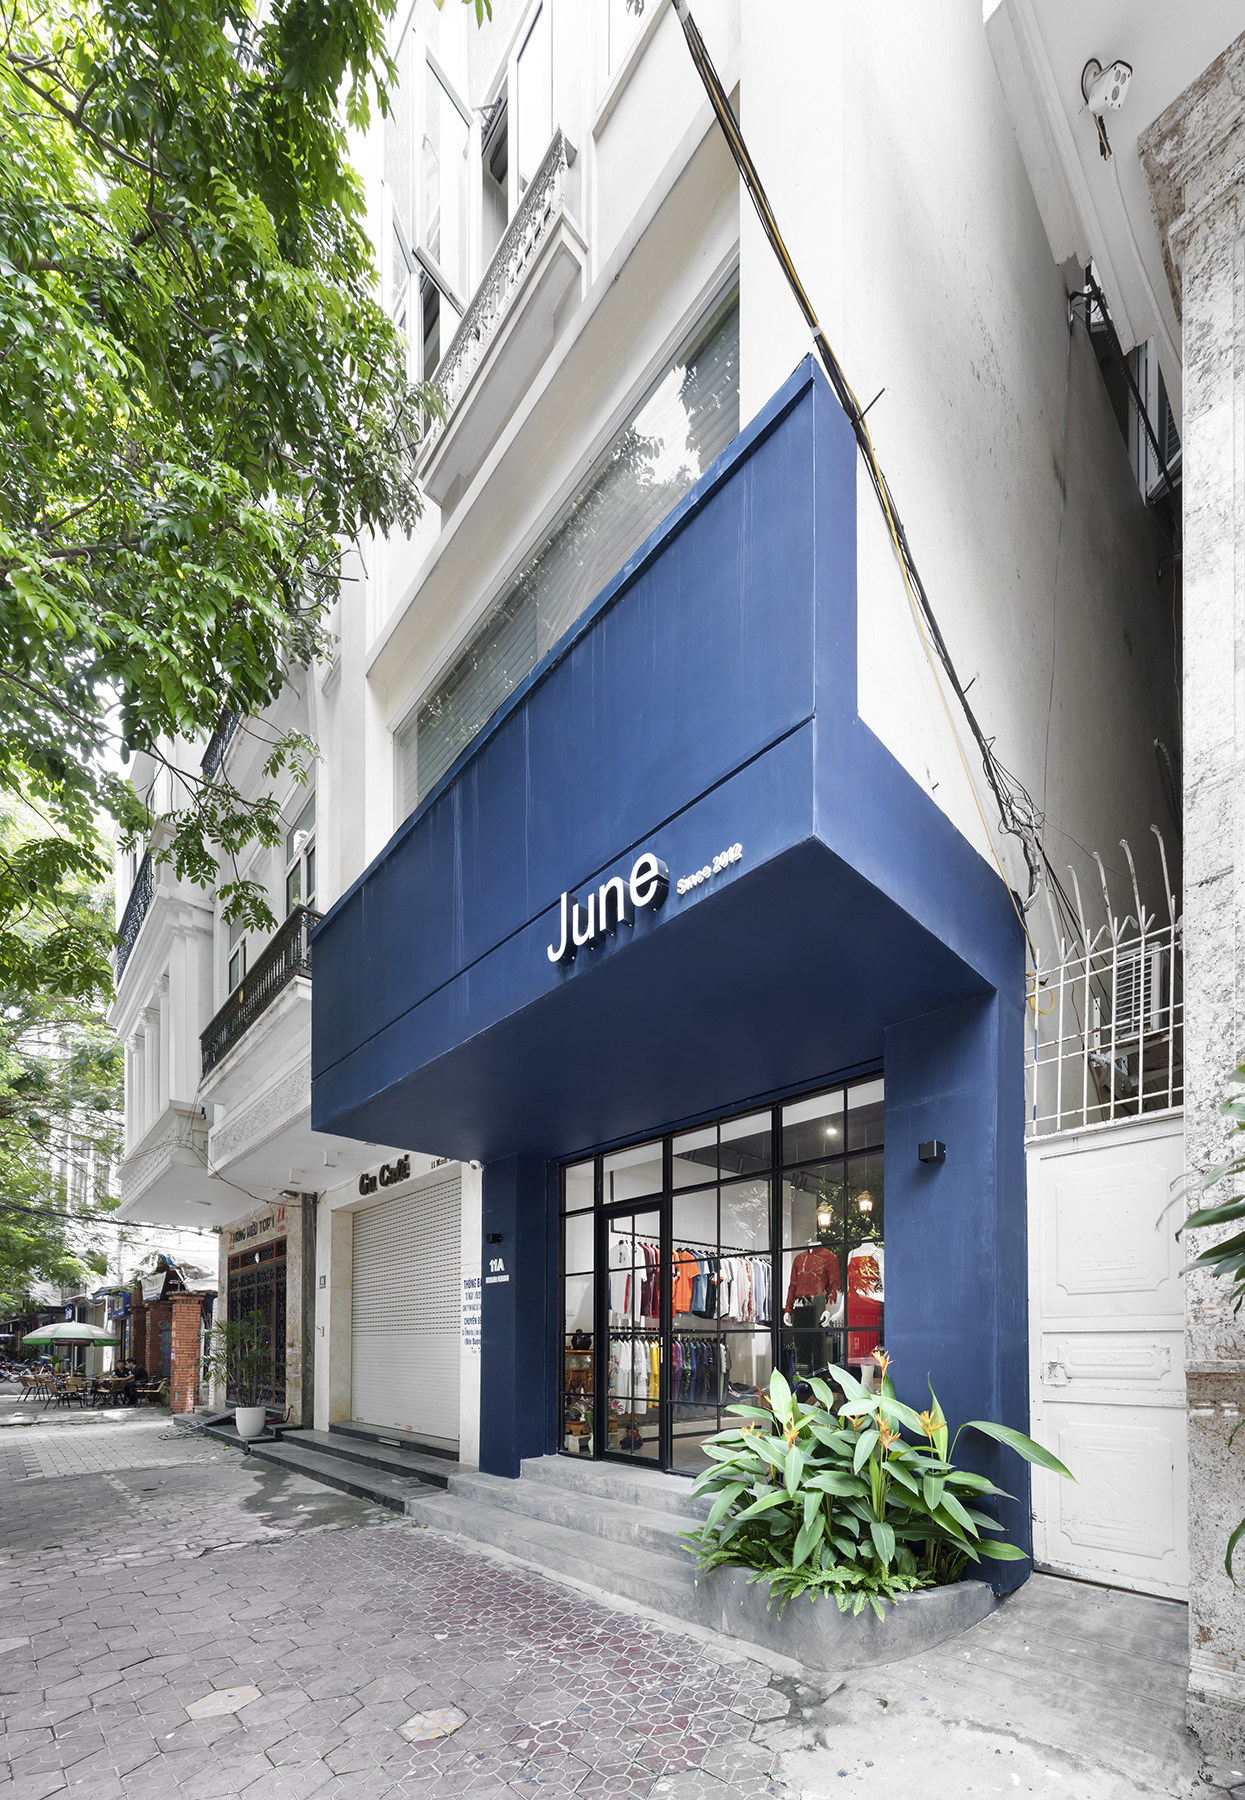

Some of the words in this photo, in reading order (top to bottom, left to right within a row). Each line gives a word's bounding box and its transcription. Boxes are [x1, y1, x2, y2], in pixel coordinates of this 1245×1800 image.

[547, 852, 664, 964] June
[677, 865, 711, 895] Since
[712, 842, 742, 874] 2012
[359, 1173, 378, 1196] Gu
[489, 1257, 505, 1273] 11A
